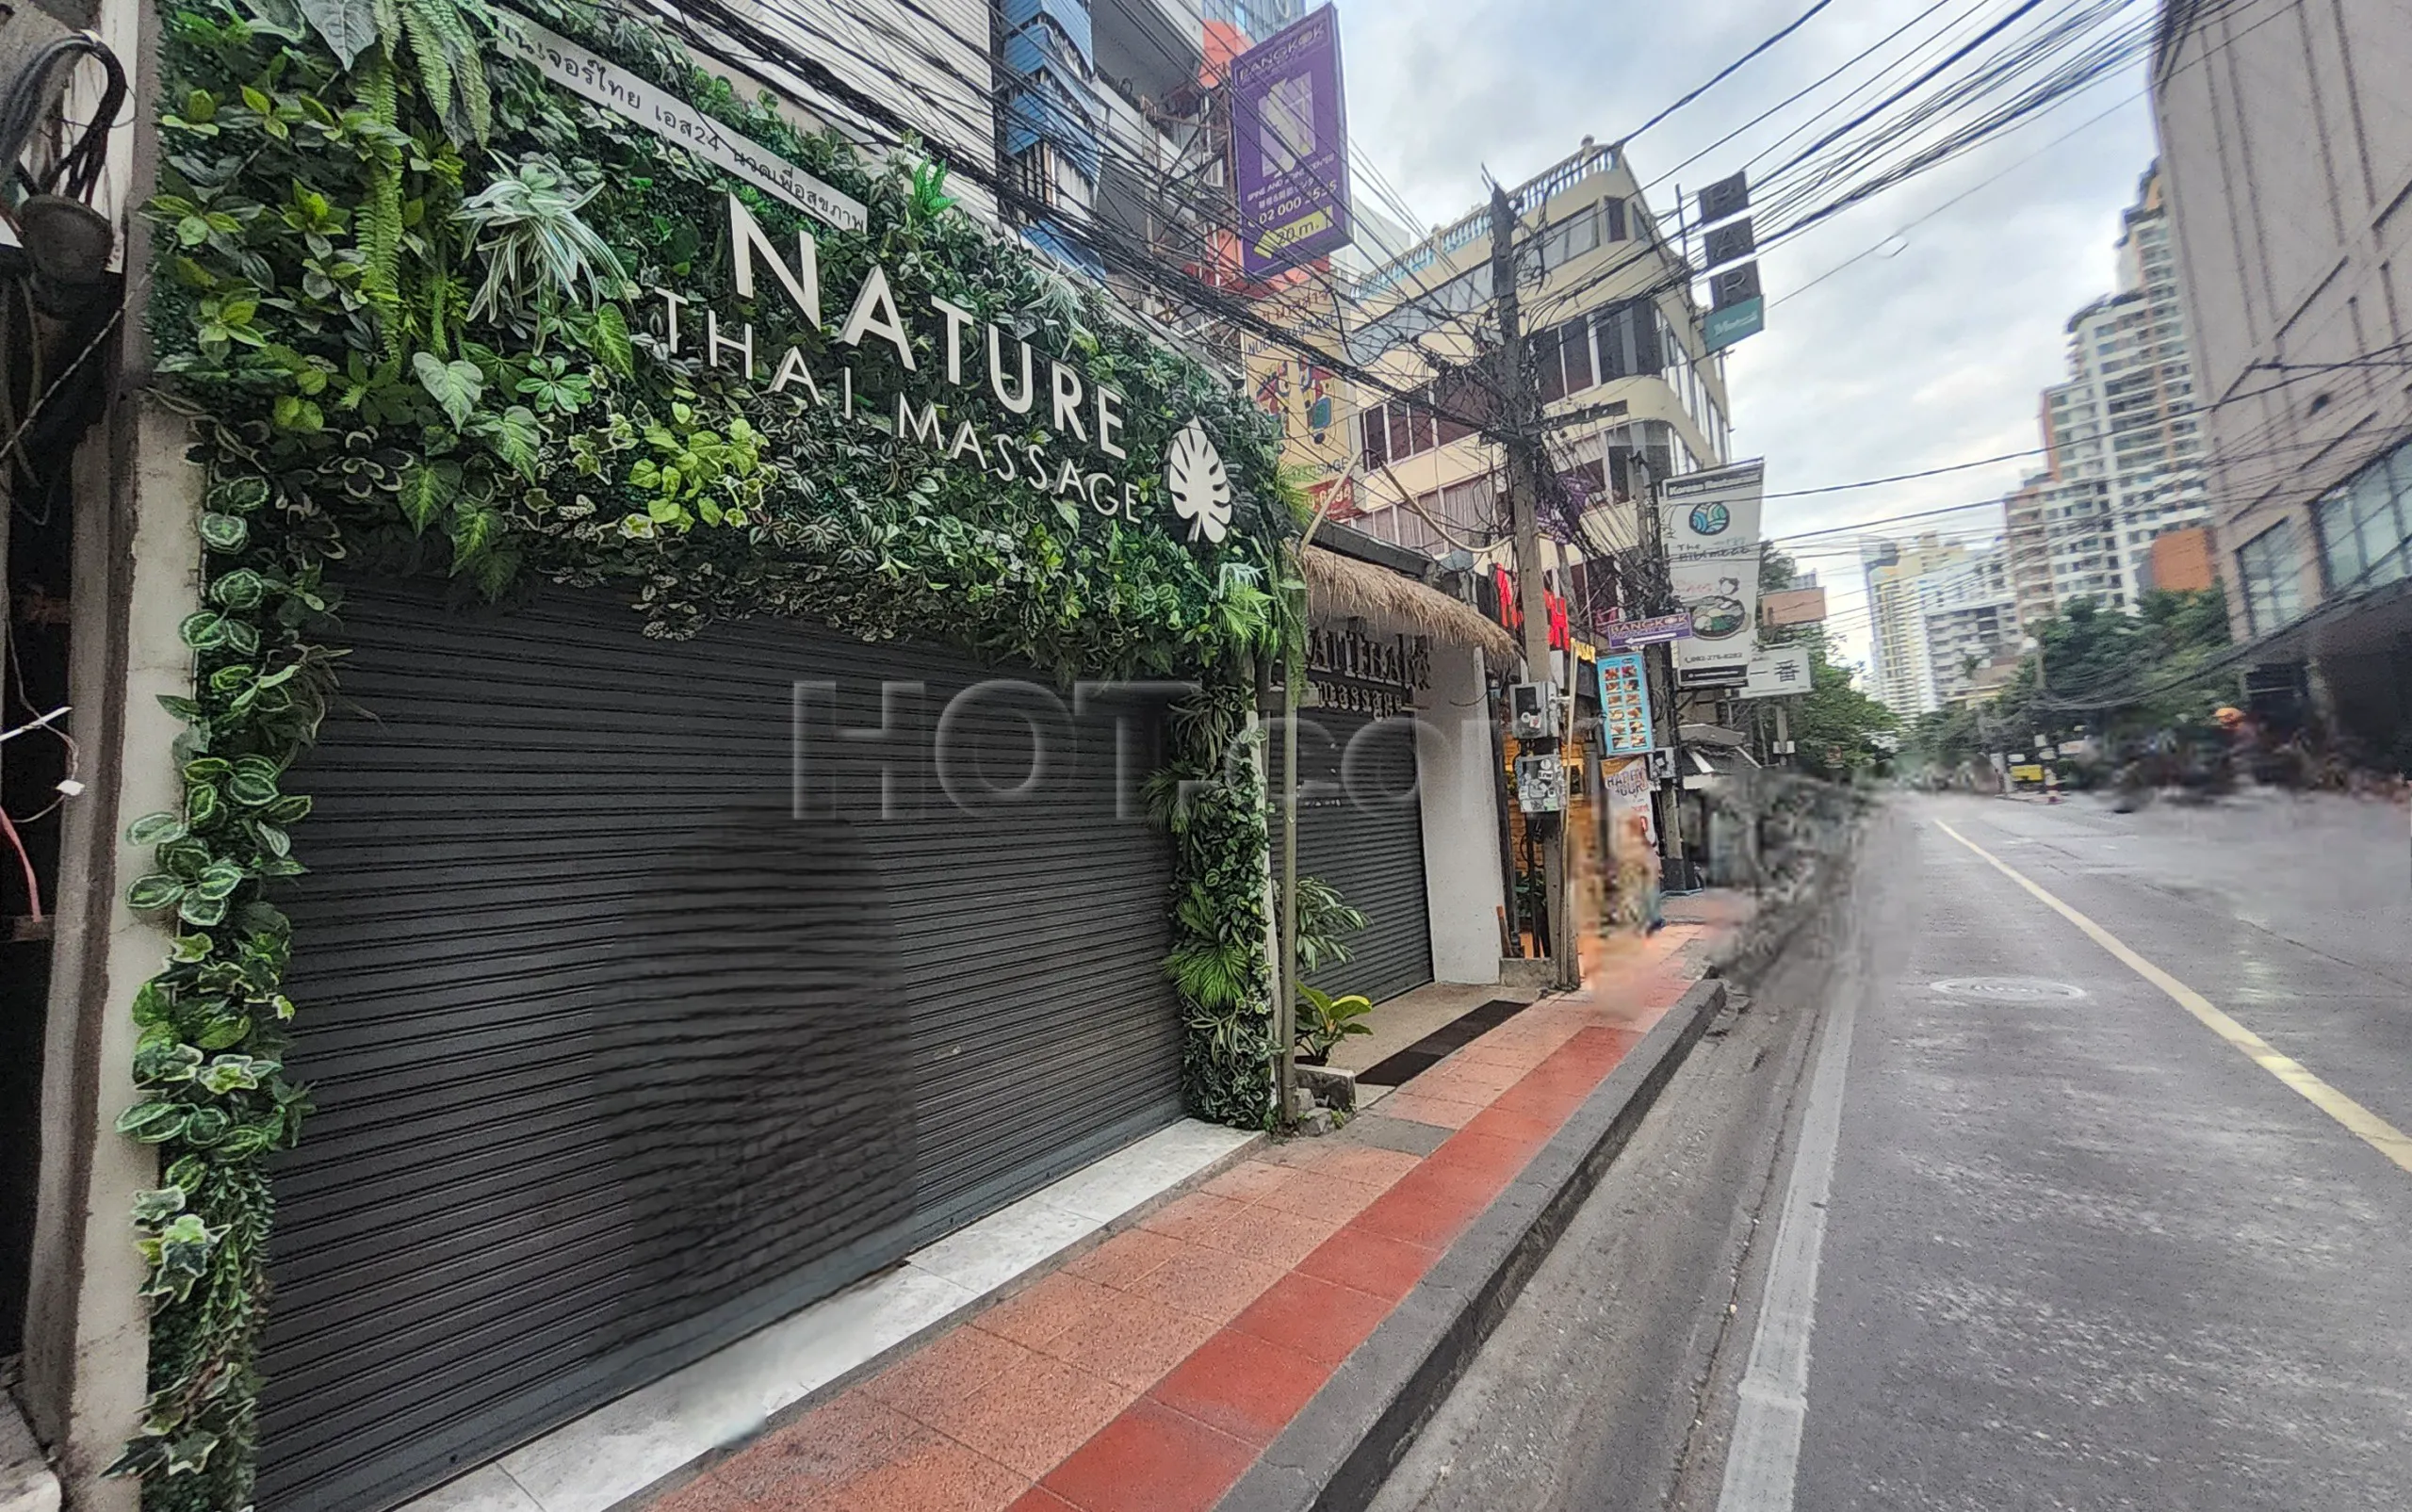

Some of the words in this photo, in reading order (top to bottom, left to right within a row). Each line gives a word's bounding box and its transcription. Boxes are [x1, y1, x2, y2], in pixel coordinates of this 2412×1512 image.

[729, 191, 1128, 461] NATURE
[1277, 196, 1302, 217] 000
[654, 285, 853, 420] THAI
[897, 391, 1142, 524] MASSAGE
